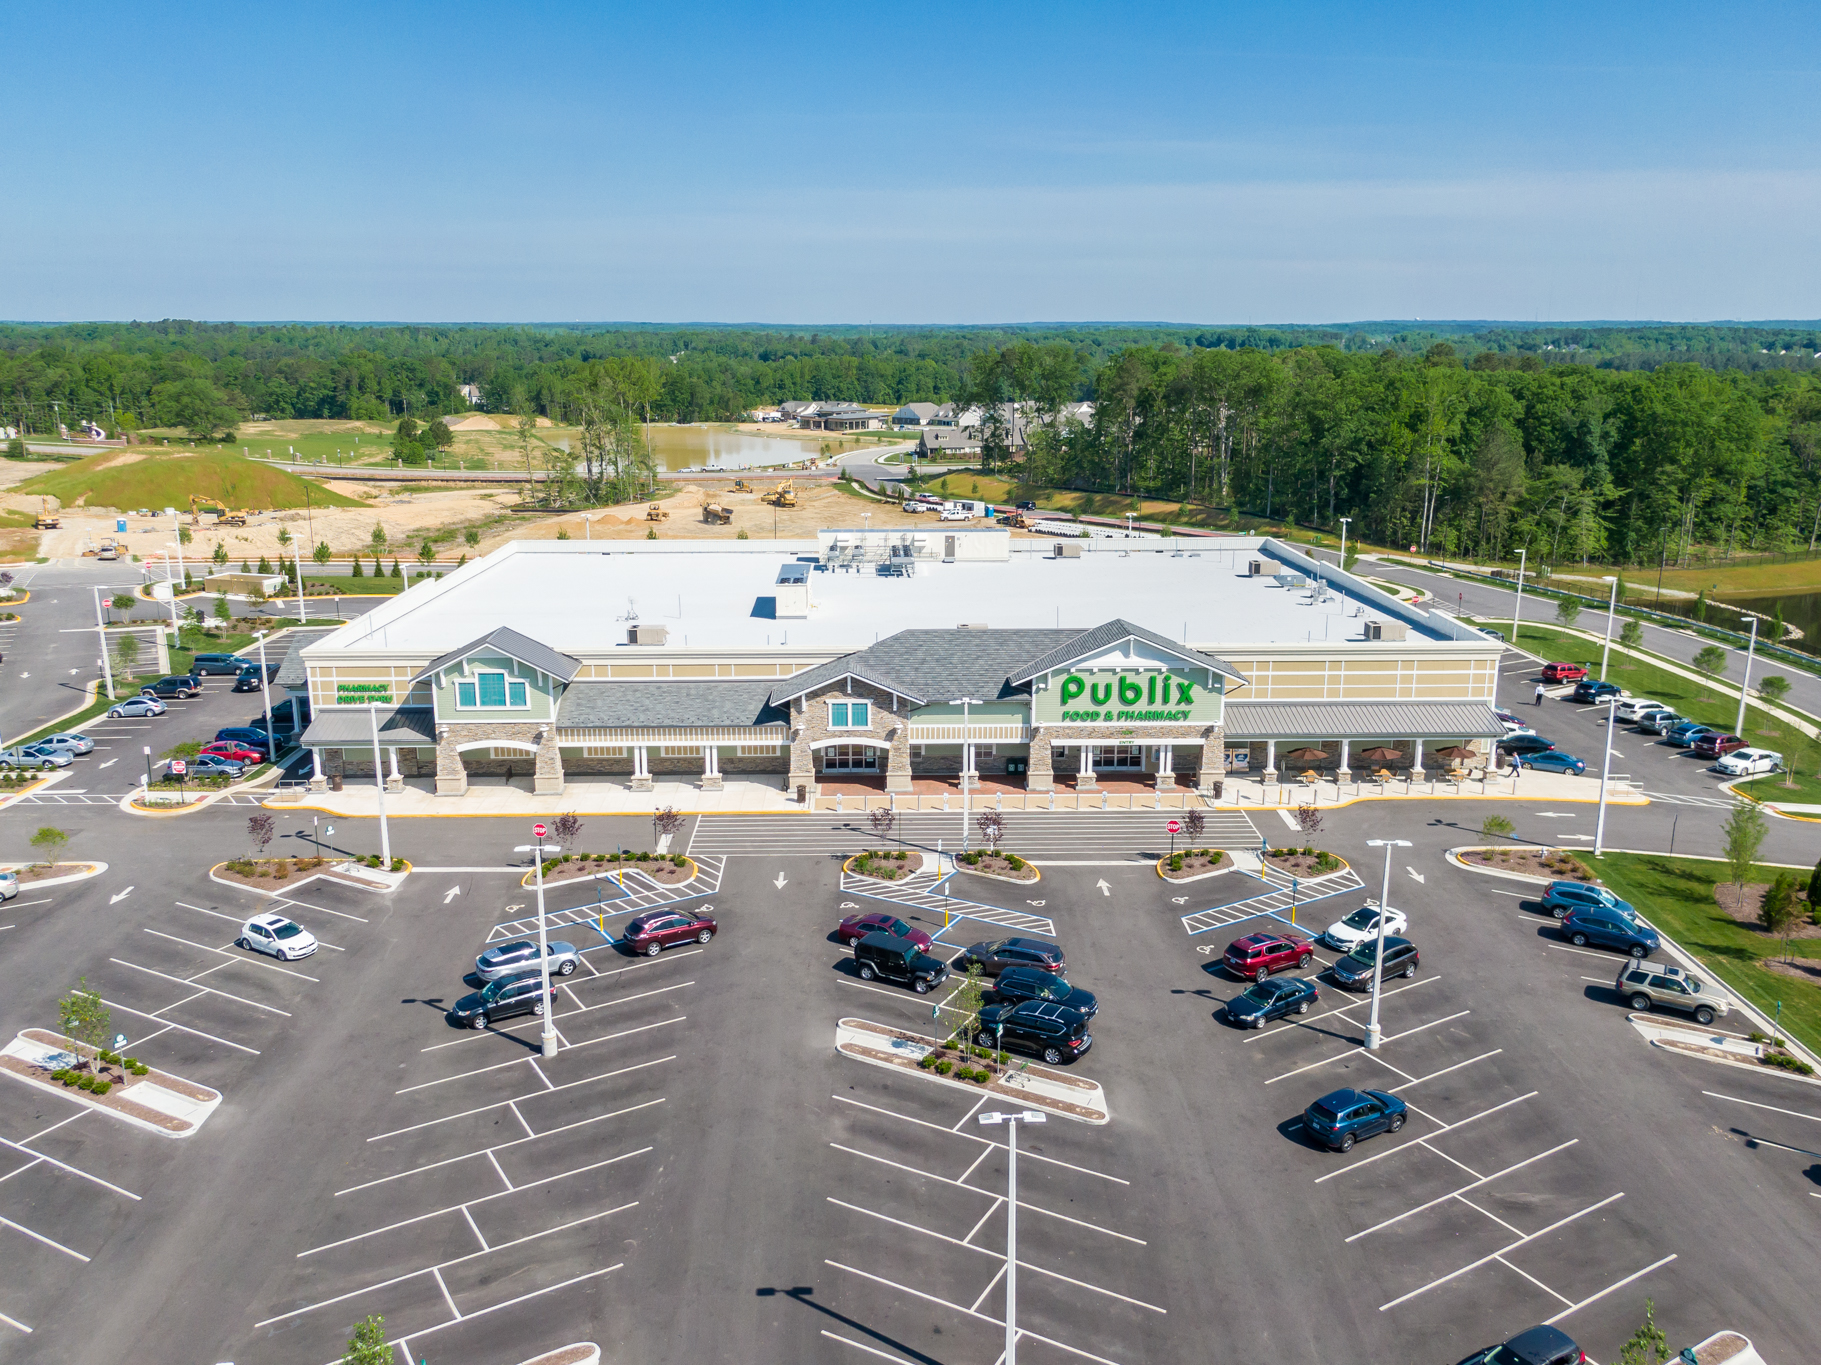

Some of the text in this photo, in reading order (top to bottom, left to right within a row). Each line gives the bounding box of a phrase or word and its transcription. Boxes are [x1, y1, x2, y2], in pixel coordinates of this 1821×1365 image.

[338, 684, 390, 692] PHARMACY
[1063, 674, 1196, 705] Publix
[337, 695, 393, 703] DRIVE THRU
[1064, 710, 1192, 721] FOOD & PHARMACY
